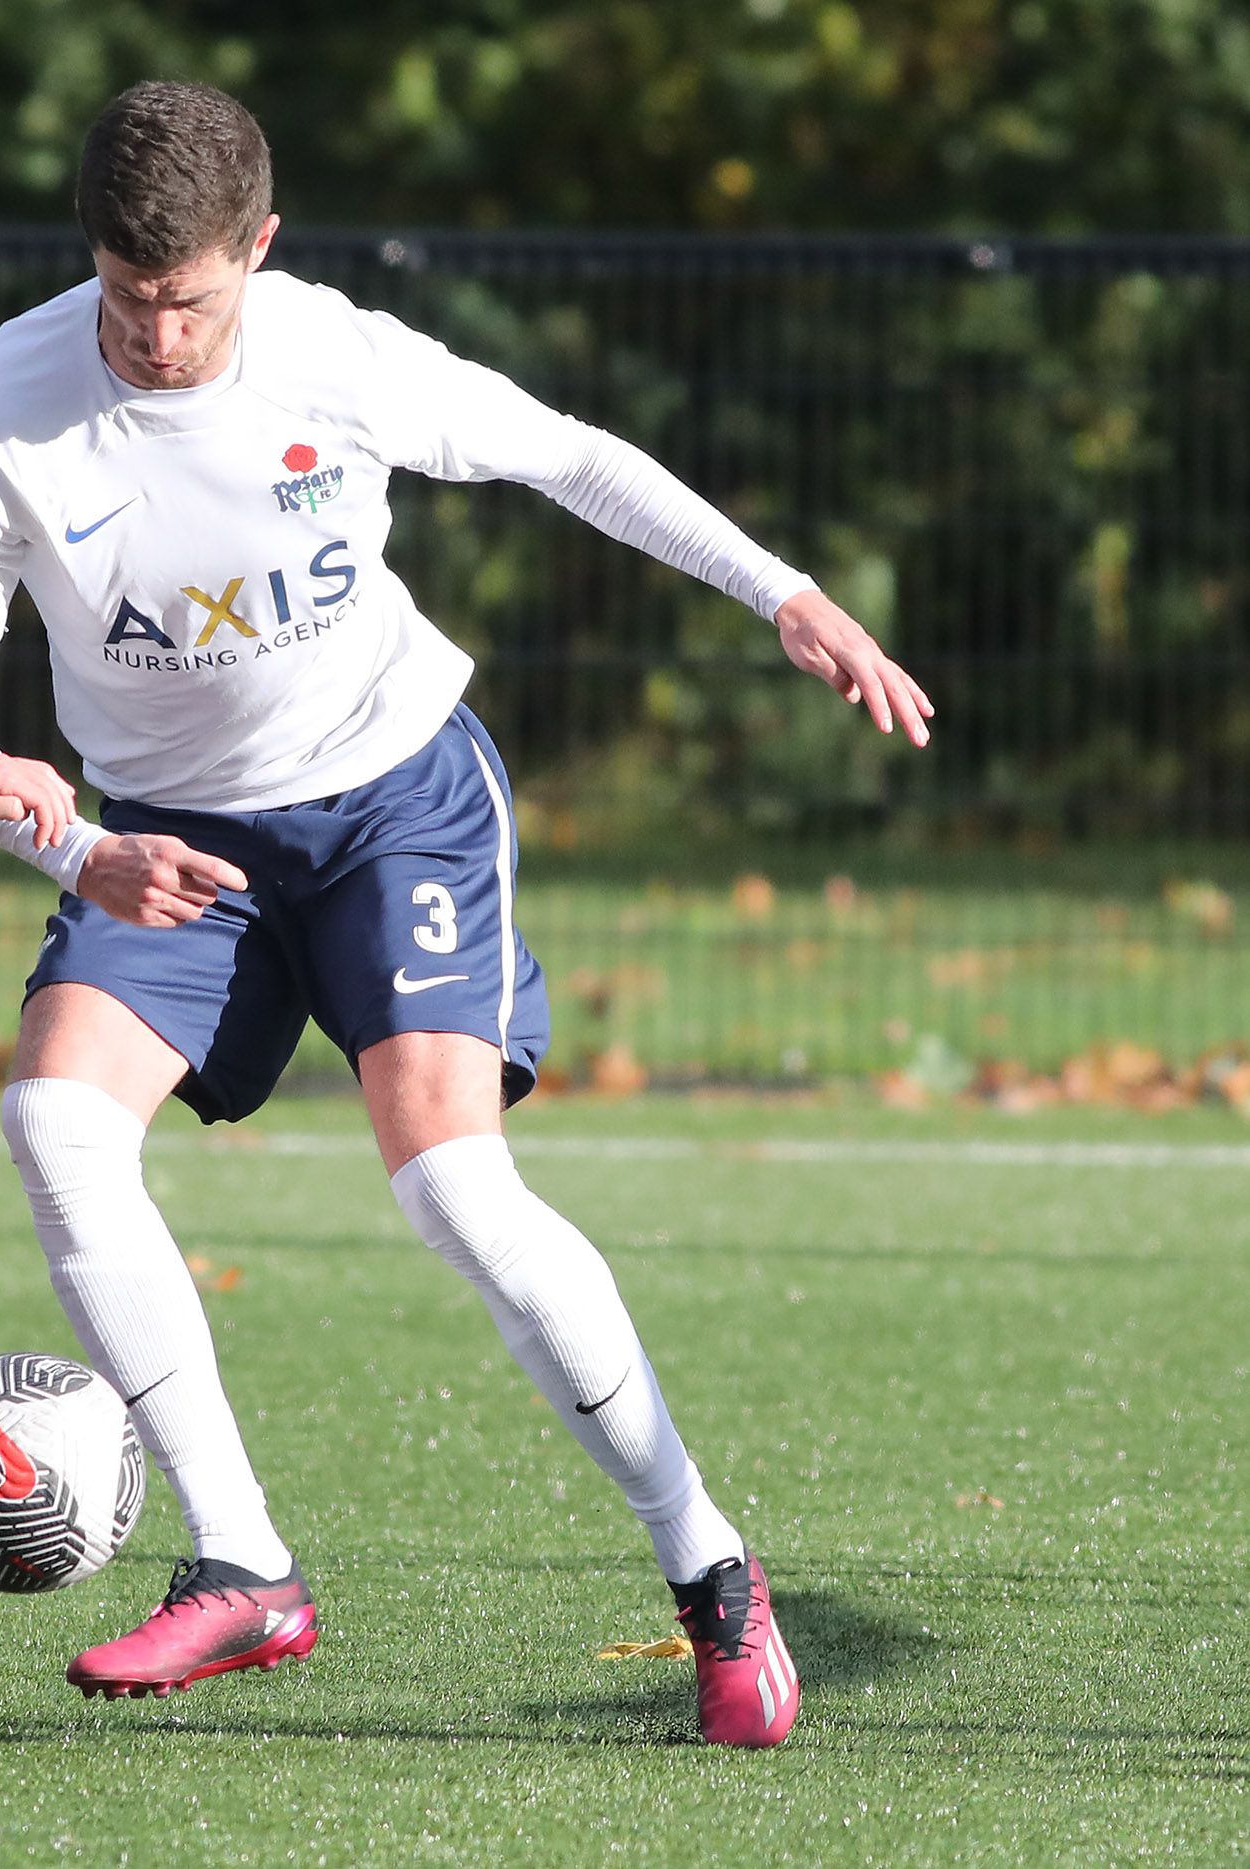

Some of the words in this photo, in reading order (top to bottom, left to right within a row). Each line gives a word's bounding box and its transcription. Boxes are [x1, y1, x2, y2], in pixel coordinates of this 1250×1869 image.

[270, 464, 344, 513] Rosario
[319, 488, 332, 500] FC
[103, 646, 238, 672] NURSING
[254, 590, 361, 659] AGENCY
[104, 540, 356, 650] AXIS
[412, 881, 459, 955] 3
